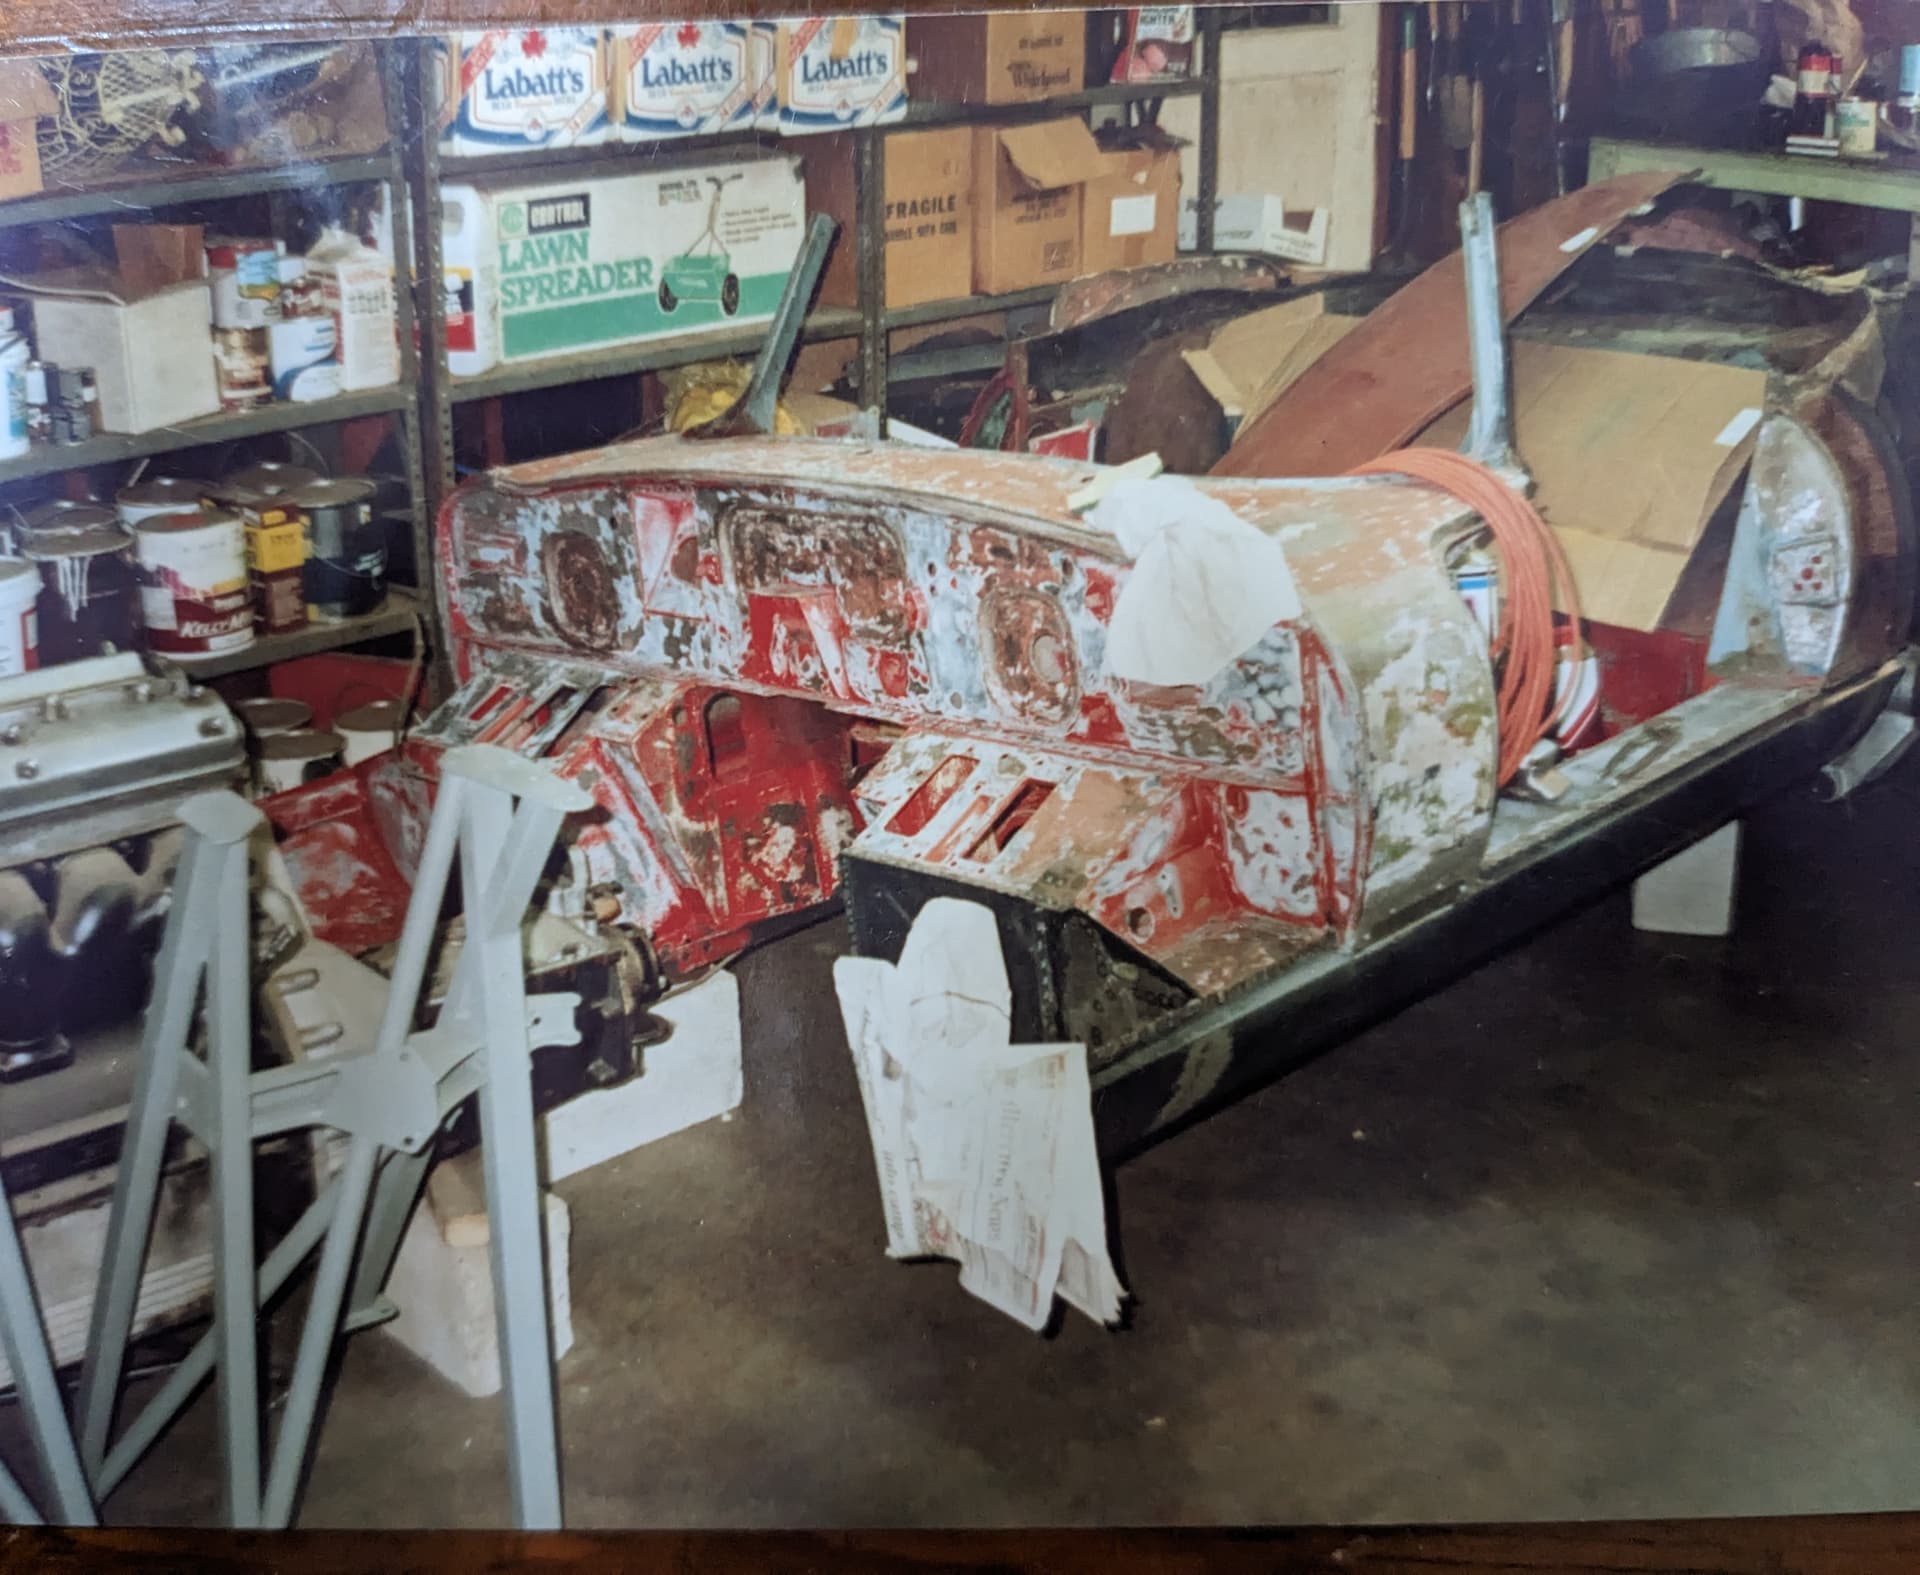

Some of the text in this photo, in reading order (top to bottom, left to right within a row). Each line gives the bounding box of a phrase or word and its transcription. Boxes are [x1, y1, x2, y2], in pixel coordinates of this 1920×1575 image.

[485, 67, 585, 101] Labatt's
[642, 56, 734, 88] Labatt's
[800, 50, 886, 84] Labatt's
[885, 193, 957, 220] FRAGILE
[499, 230, 590, 274] LAWN
[500, 256, 653, 308] SPREADER
